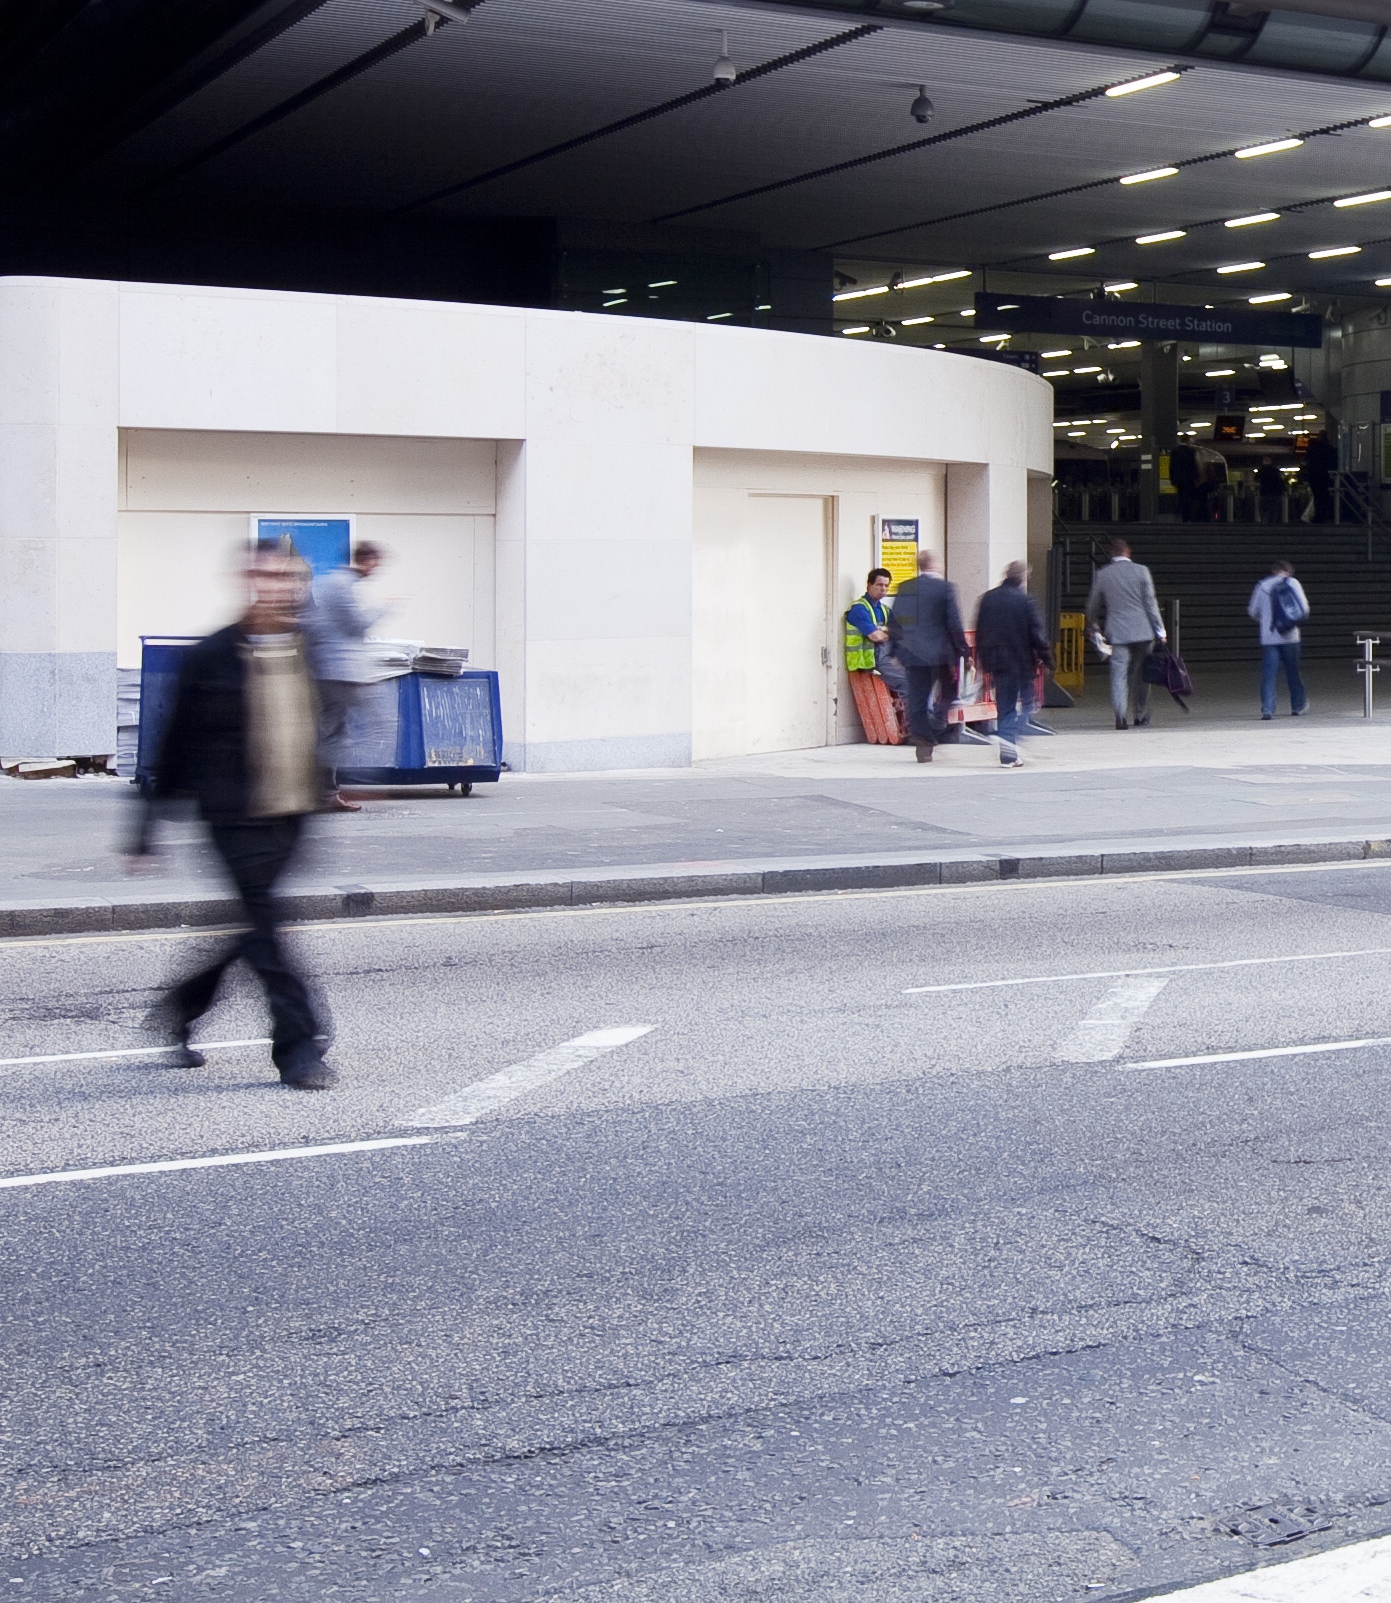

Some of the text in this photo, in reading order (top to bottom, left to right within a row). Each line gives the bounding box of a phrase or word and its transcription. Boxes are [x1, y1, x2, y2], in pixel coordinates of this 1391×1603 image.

[1082, 310, 1232, 333] Cannon Street Station
